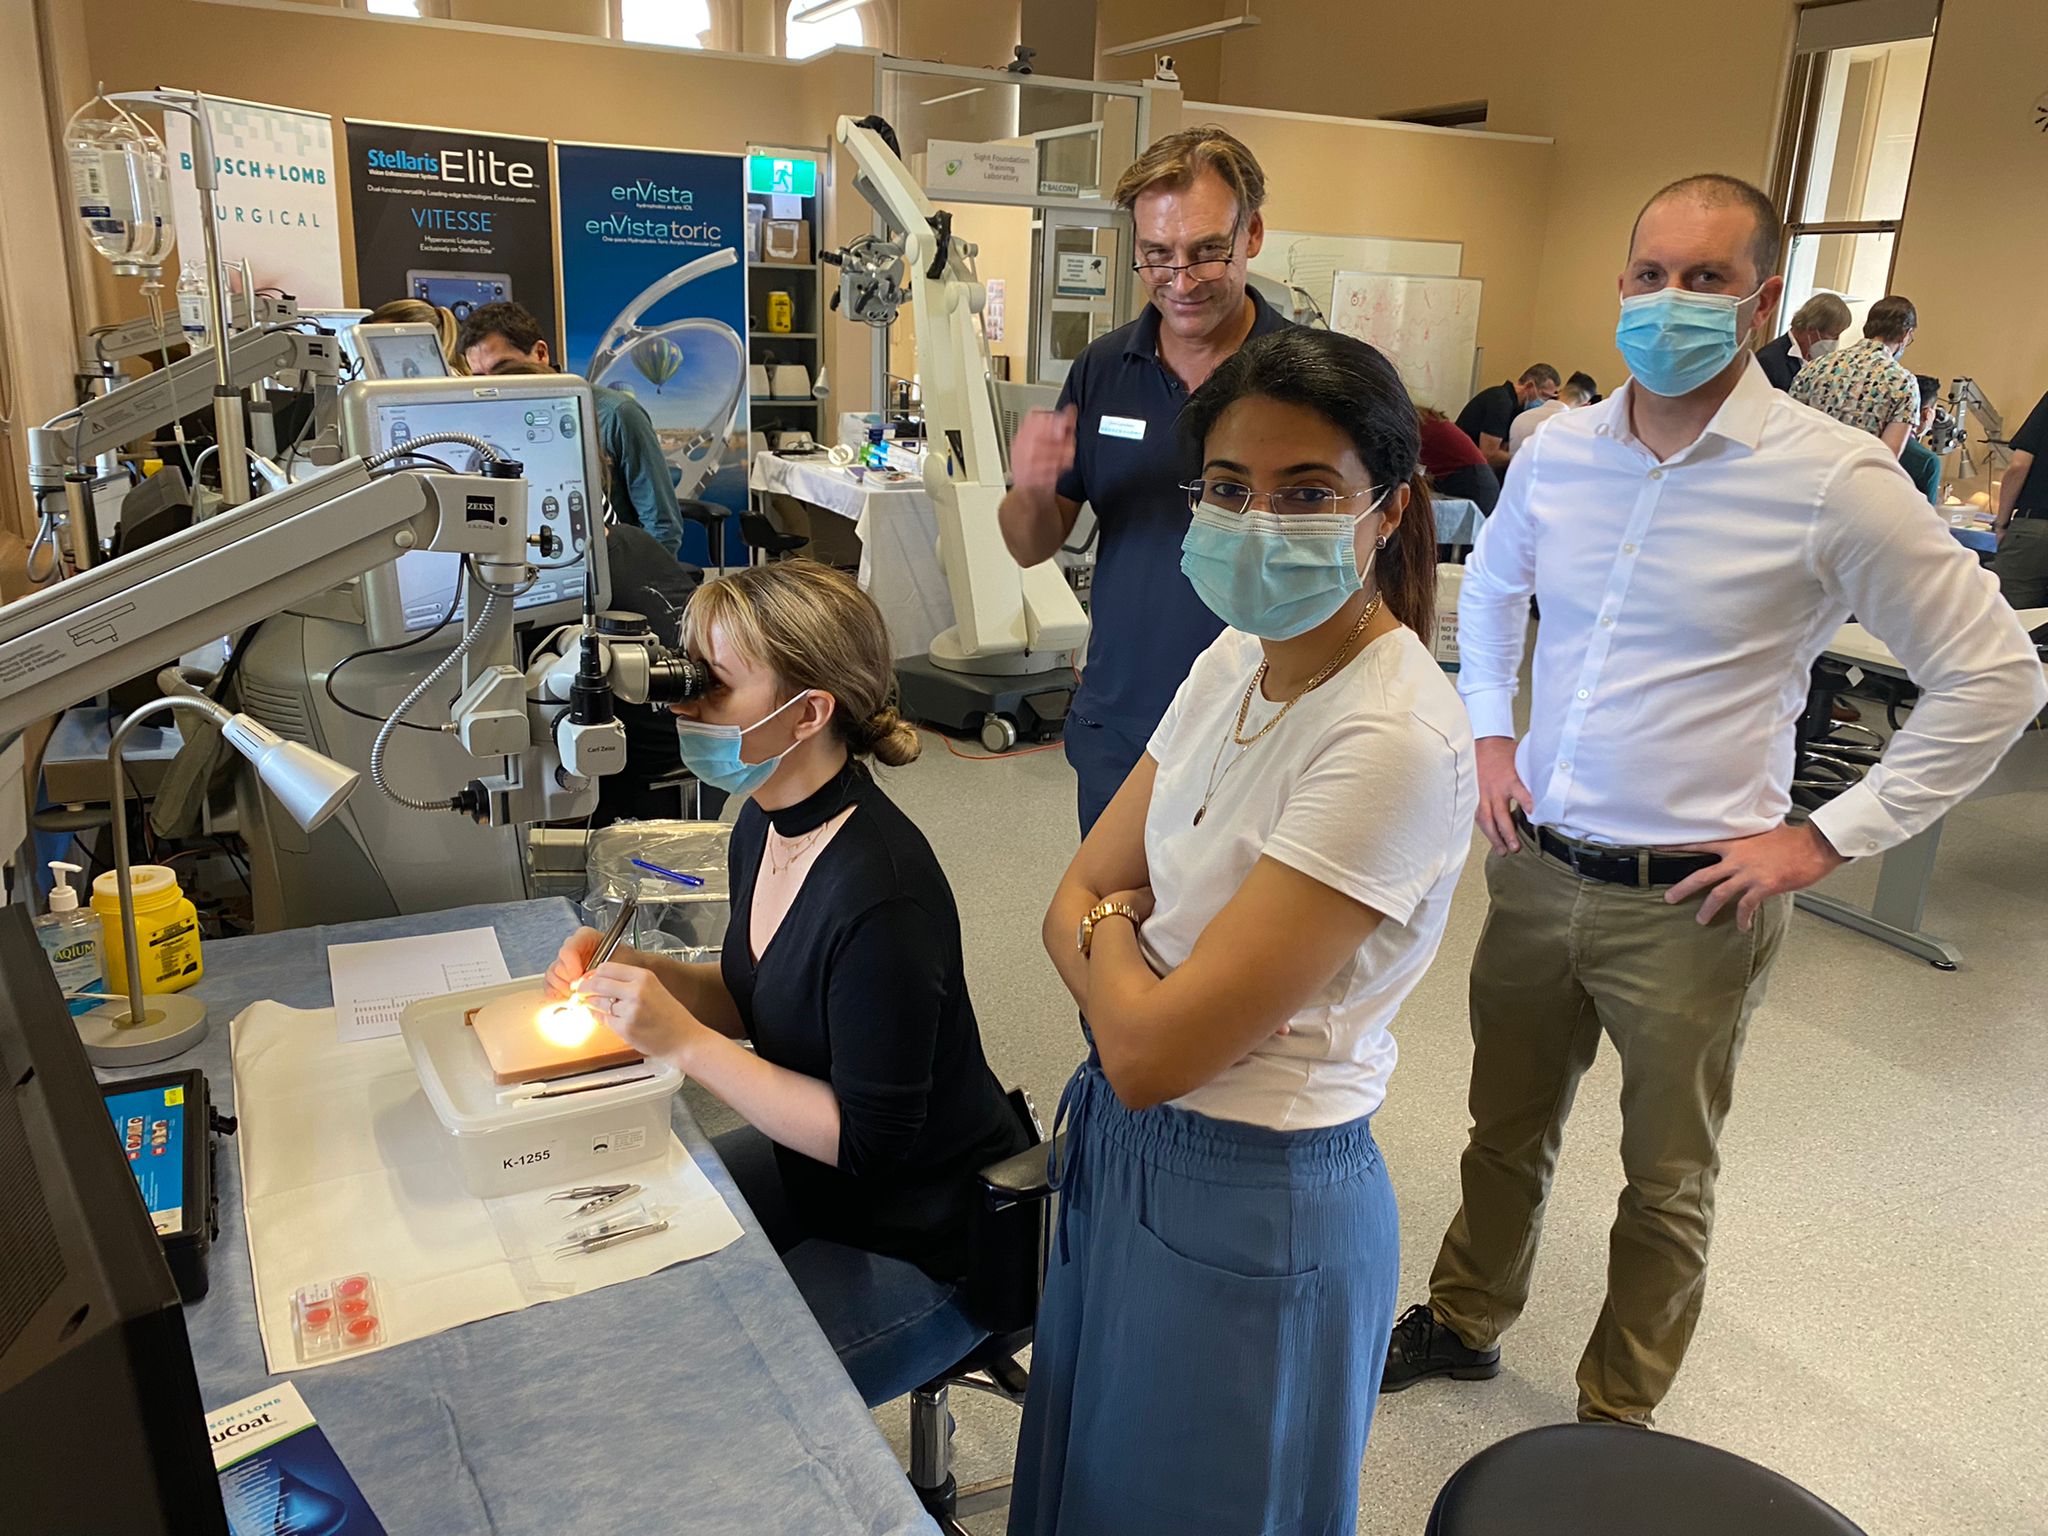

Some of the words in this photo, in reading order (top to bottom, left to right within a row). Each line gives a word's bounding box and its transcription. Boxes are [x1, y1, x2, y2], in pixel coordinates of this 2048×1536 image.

[180, 152, 327, 185] BUSCH+LOMB
[368, 149, 439, 172] Stellaris
[440, 149, 535, 188] Elite
[973, 152, 991, 162] Sight
[992, 154, 1030, 164] Foundation
[988, 163, 1015, 174] Training
[984, 172, 1019, 182] Laboratory
[1047, 183, 1076, 193] BALCONY
[611, 180, 693, 205] enVista
[216, 204, 321, 229] URGICAL
[411, 207, 493, 232] VITESSE
[585, 214, 668, 237] enVista
[670, 221, 721, 240] toric
[467, 502, 494, 511] ZEISS
[683, 665, 692, 678] Carl
[55, 942, 95, 961] AQIUM
[503, 1149, 551, 1170] K-1255
[209, 1398, 281, 1429] SCH+LOMB
[211, 1413, 272, 1445] uCoat
